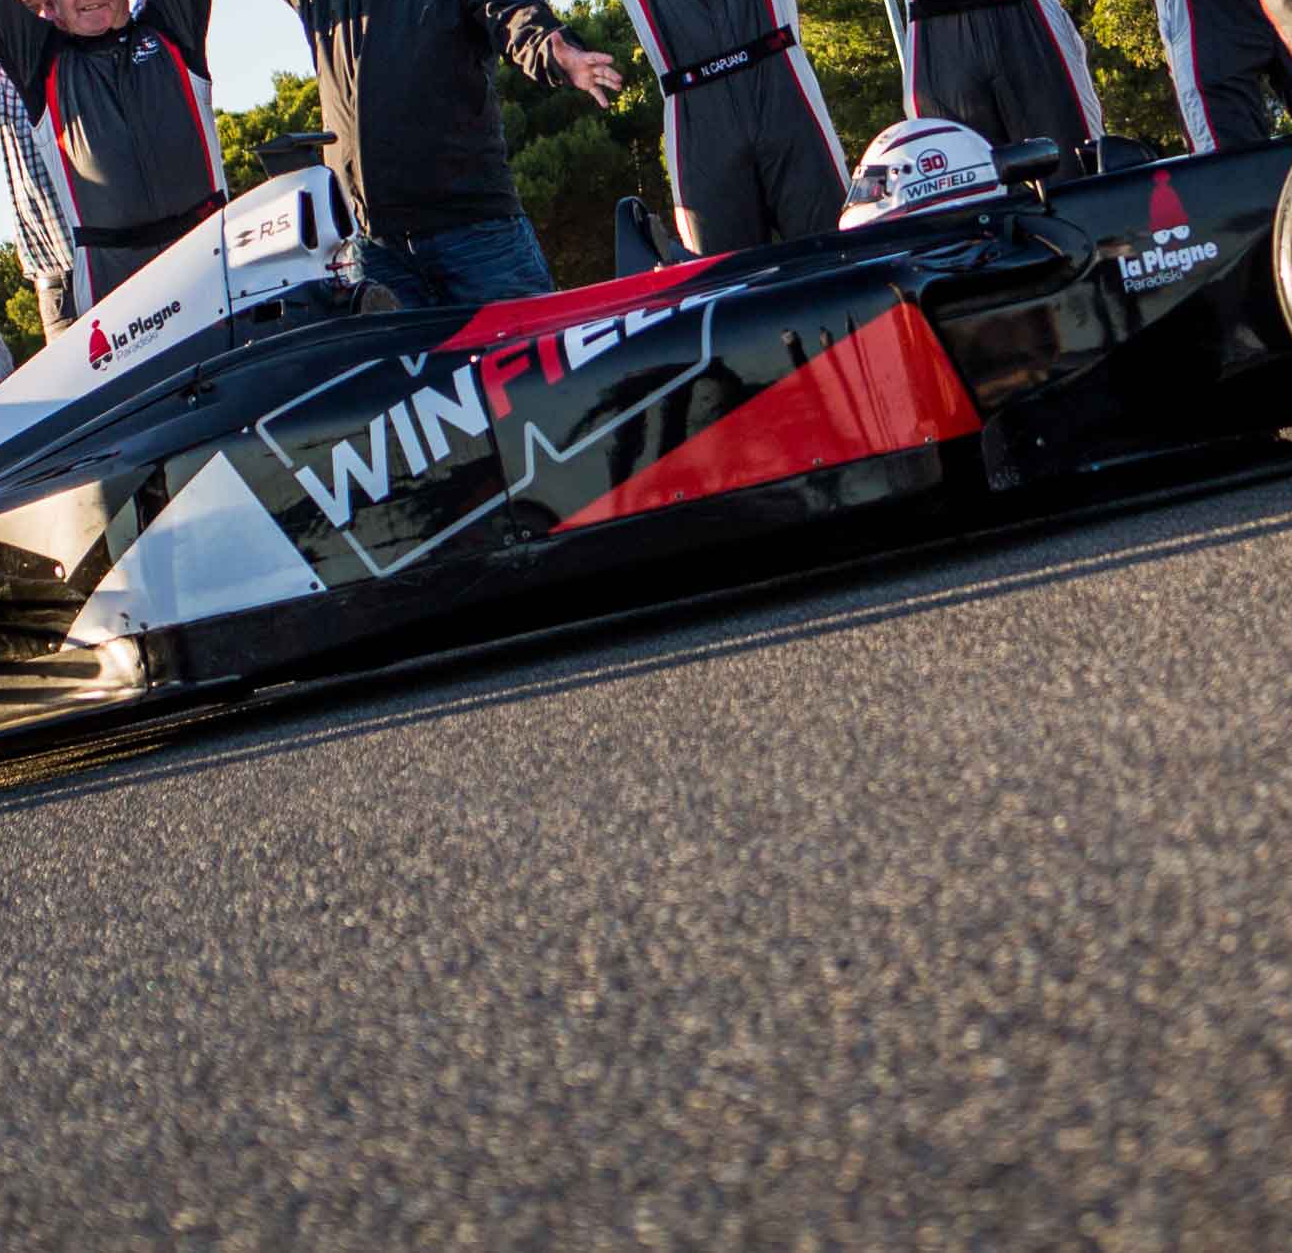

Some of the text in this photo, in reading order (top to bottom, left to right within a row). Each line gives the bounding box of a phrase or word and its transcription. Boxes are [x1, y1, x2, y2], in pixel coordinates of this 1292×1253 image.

[920, 154, 945, 173] 30
[907, 171, 977, 199] WINFIELD
[1117, 241, 1219, 279] la Plagne
[111, 300, 182, 351] la Plagne
